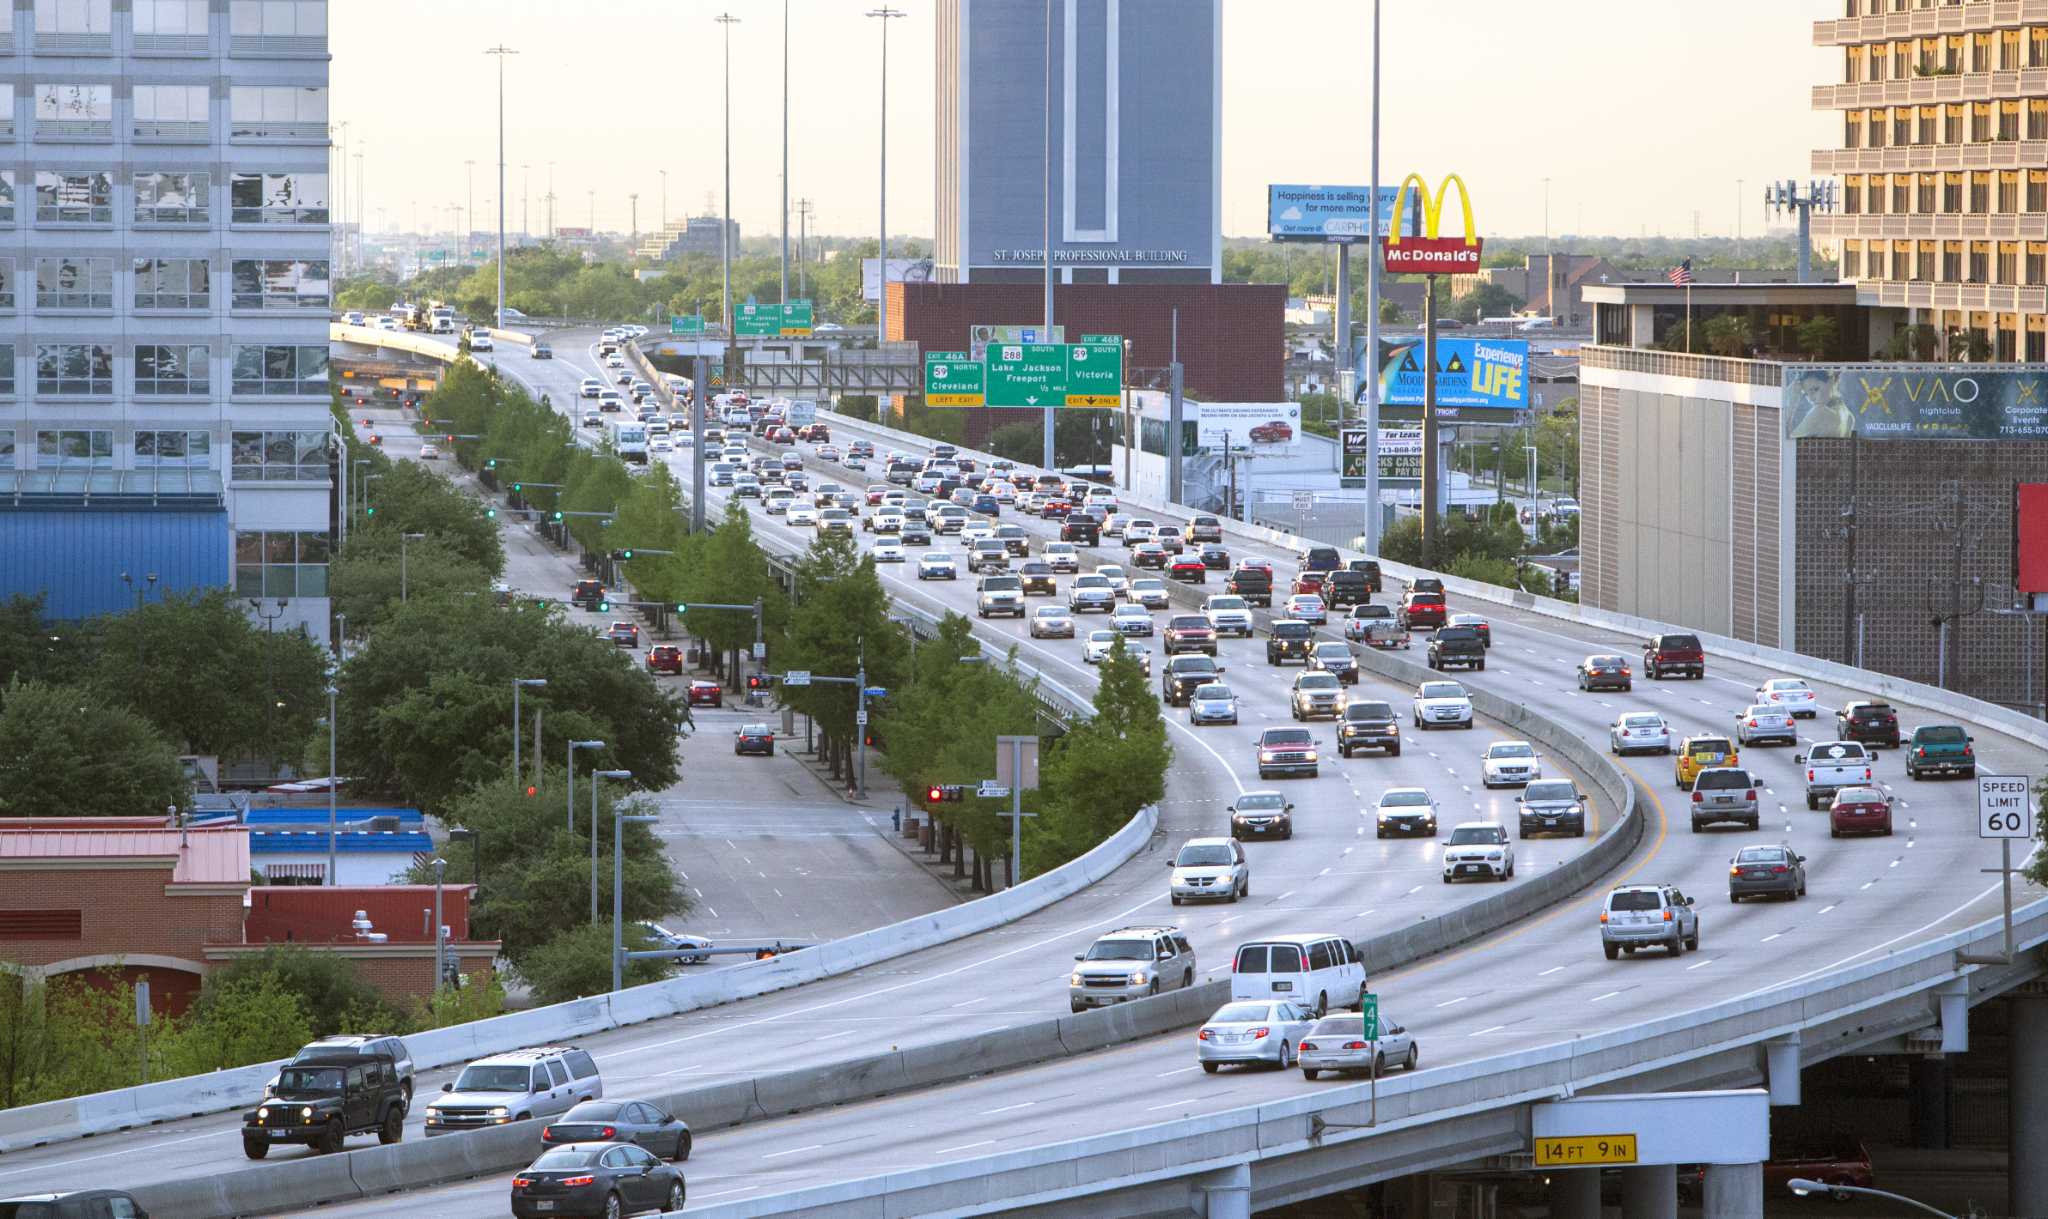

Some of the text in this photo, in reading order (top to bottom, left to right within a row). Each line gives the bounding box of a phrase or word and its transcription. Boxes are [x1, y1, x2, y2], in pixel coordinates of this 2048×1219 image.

[1278, 192, 1325, 202] Happiness
[1327, 192, 1335, 200] is
[1337, 192, 1365, 203] selling
[1305, 203, 1318, 211] for
[994, 249, 1187, 261] ST. JOSEP PROFESSIONAL BUILDING
[1387, 249, 1478, 262] McDonald's
[1102, 336, 1119, 344] 46B
[1004, 351, 1021, 360] 288
[1074, 350, 1086, 359] 59
[1474, 342, 1524, 367] Experience
[935, 367, 947, 376] 59
[991, 363, 1062, 372] Lake Jackson
[1006, 374, 1047, 384] Freeport
[1075, 370, 1114, 379] Victoria
[1471, 359, 1522, 401] LIFE
[931, 382, 979, 390] Cleveland
[1904, 377, 1979, 403] VAO
[935, 396, 953, 404] LEFT
[1067, 397, 1084, 405] EXIT
[1919, 407, 1961, 416] nightclub
[2005, 406, 2048, 415] Corporate
[2013, 415, 2040, 424] Events
[1999, 425, 2048, 434] 713-655-070
[1982, 782, 2025, 793] SPEED
[1987, 797, 2021, 808] LIMIT
[1988, 812, 2021, 831] 60
[1545, 1141, 1626, 1160] 14 FT 9 IN
